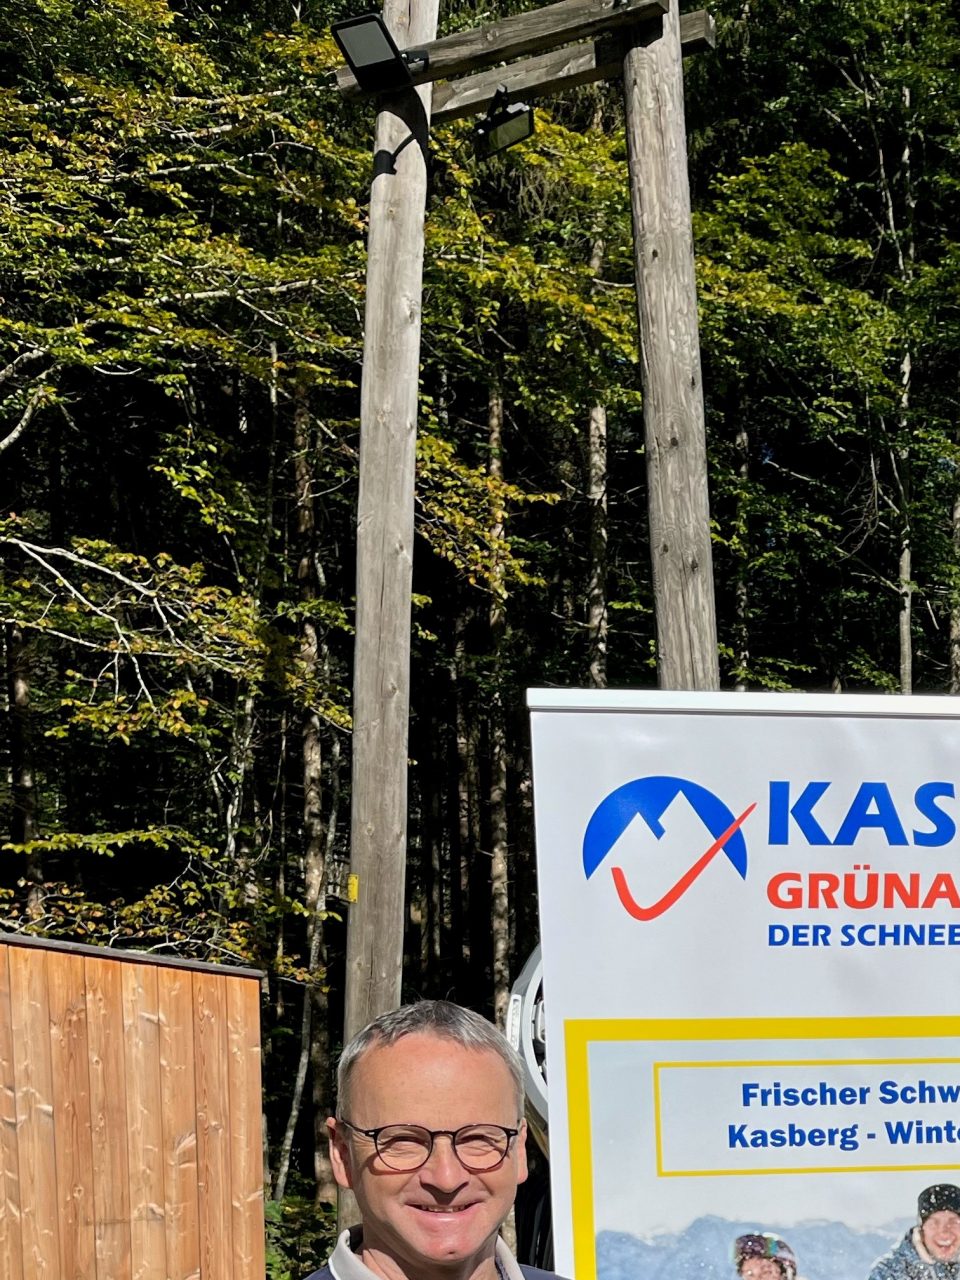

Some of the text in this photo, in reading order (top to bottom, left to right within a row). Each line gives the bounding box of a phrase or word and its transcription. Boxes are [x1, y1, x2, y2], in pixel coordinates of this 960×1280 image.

[768, 924, 832, 947] DER
[742, 1081, 870, 1107] Frischer
[729, 1124, 859, 1151] Kasberg
